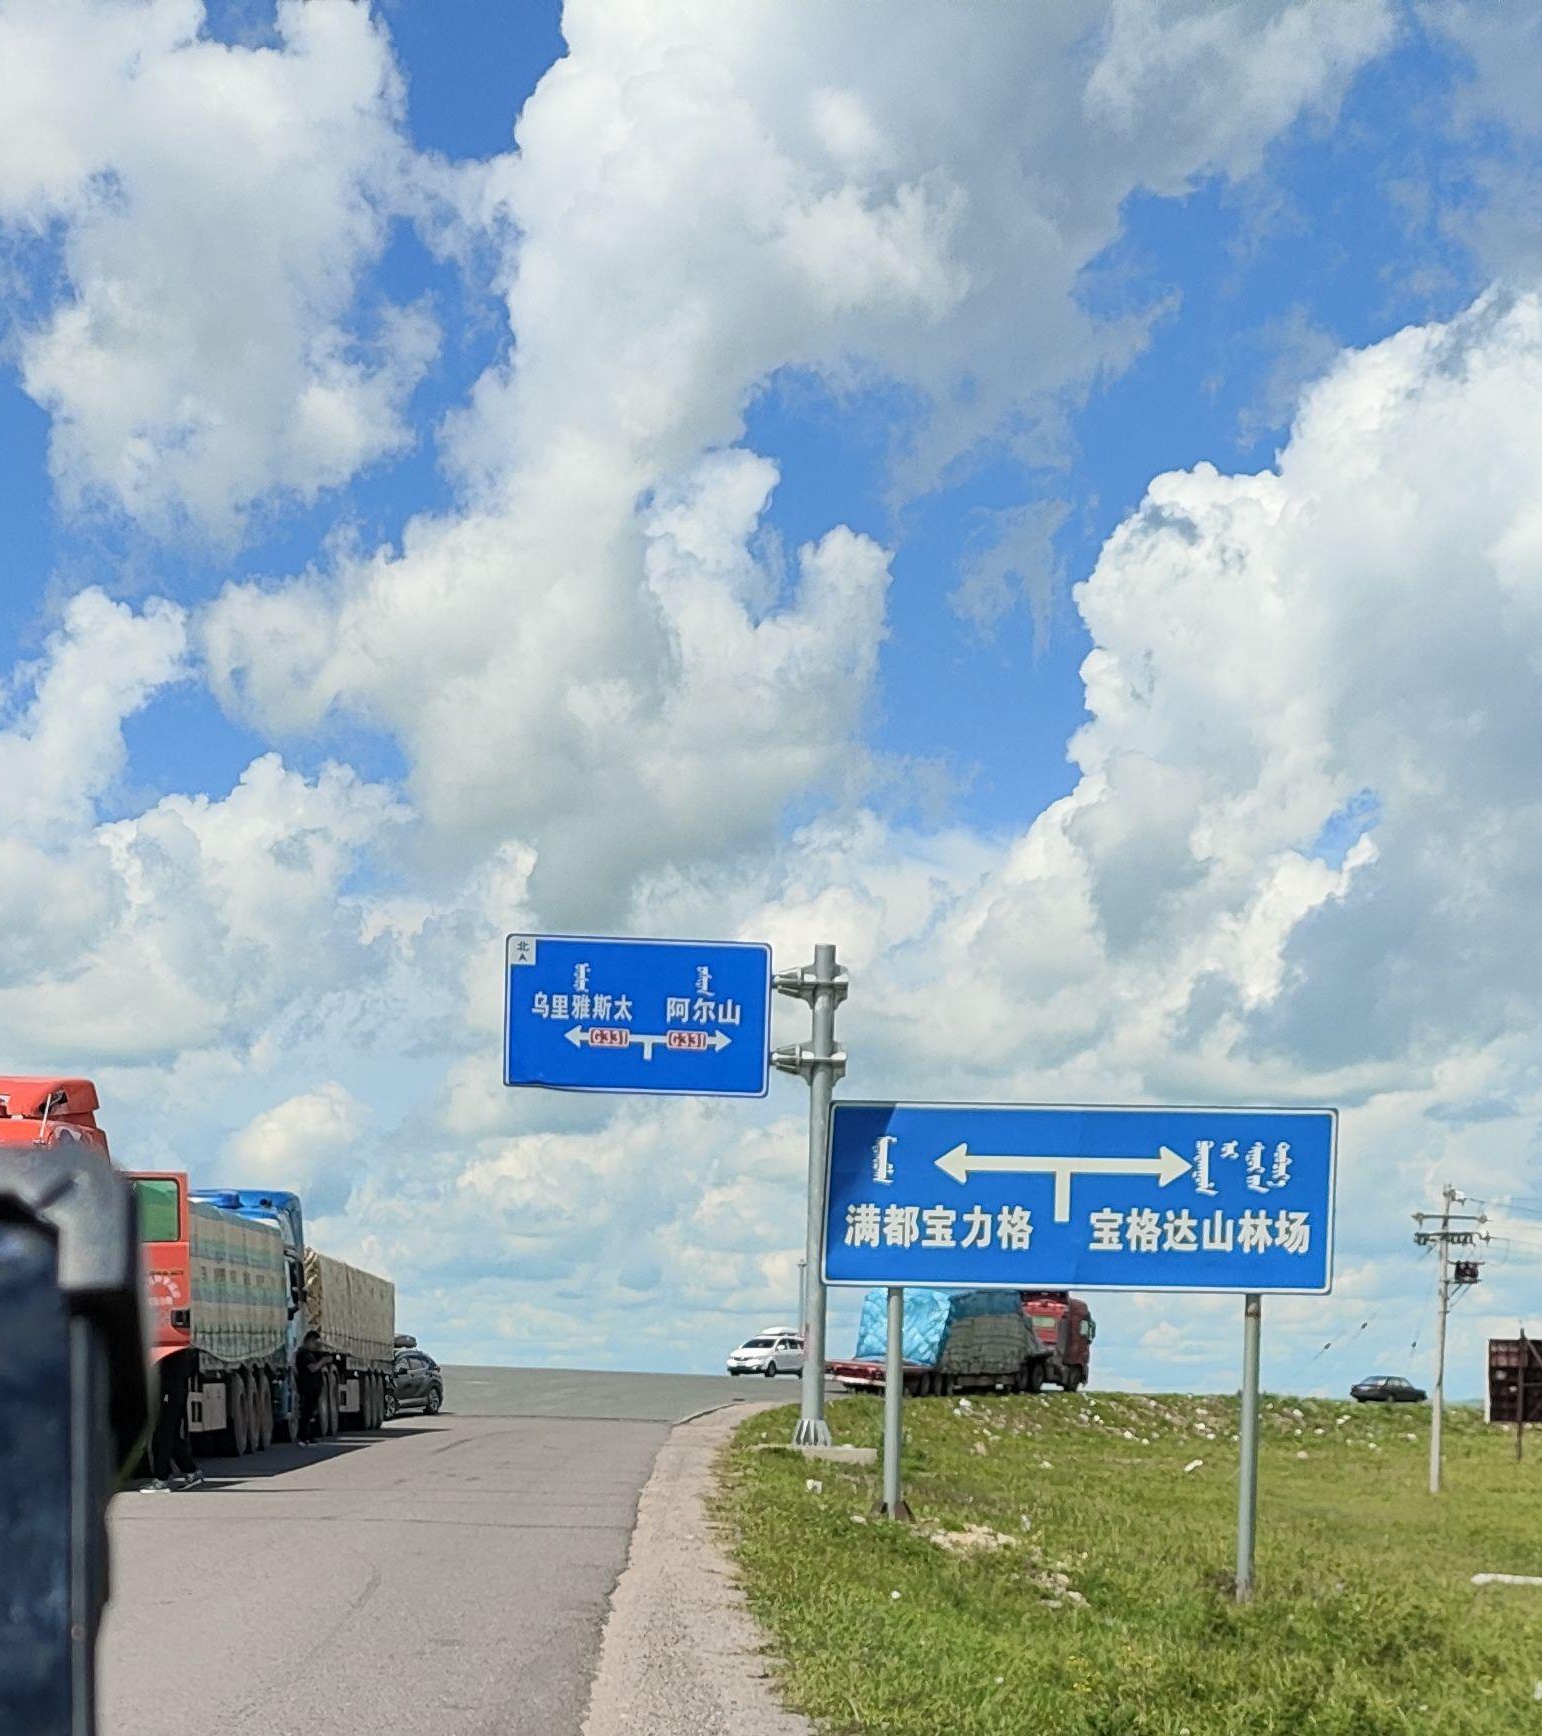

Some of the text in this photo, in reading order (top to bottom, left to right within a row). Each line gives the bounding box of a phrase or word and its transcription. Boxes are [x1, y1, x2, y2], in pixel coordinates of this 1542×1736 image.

[516, 940, 530, 952] 北
[531, 991, 741, 1025] 乌里雅斯太 阿尔山
[592, 1029, 706, 1048] G331 G331
[844, 1203, 1311, 1255] 满都宝力格 宝格达山林场
